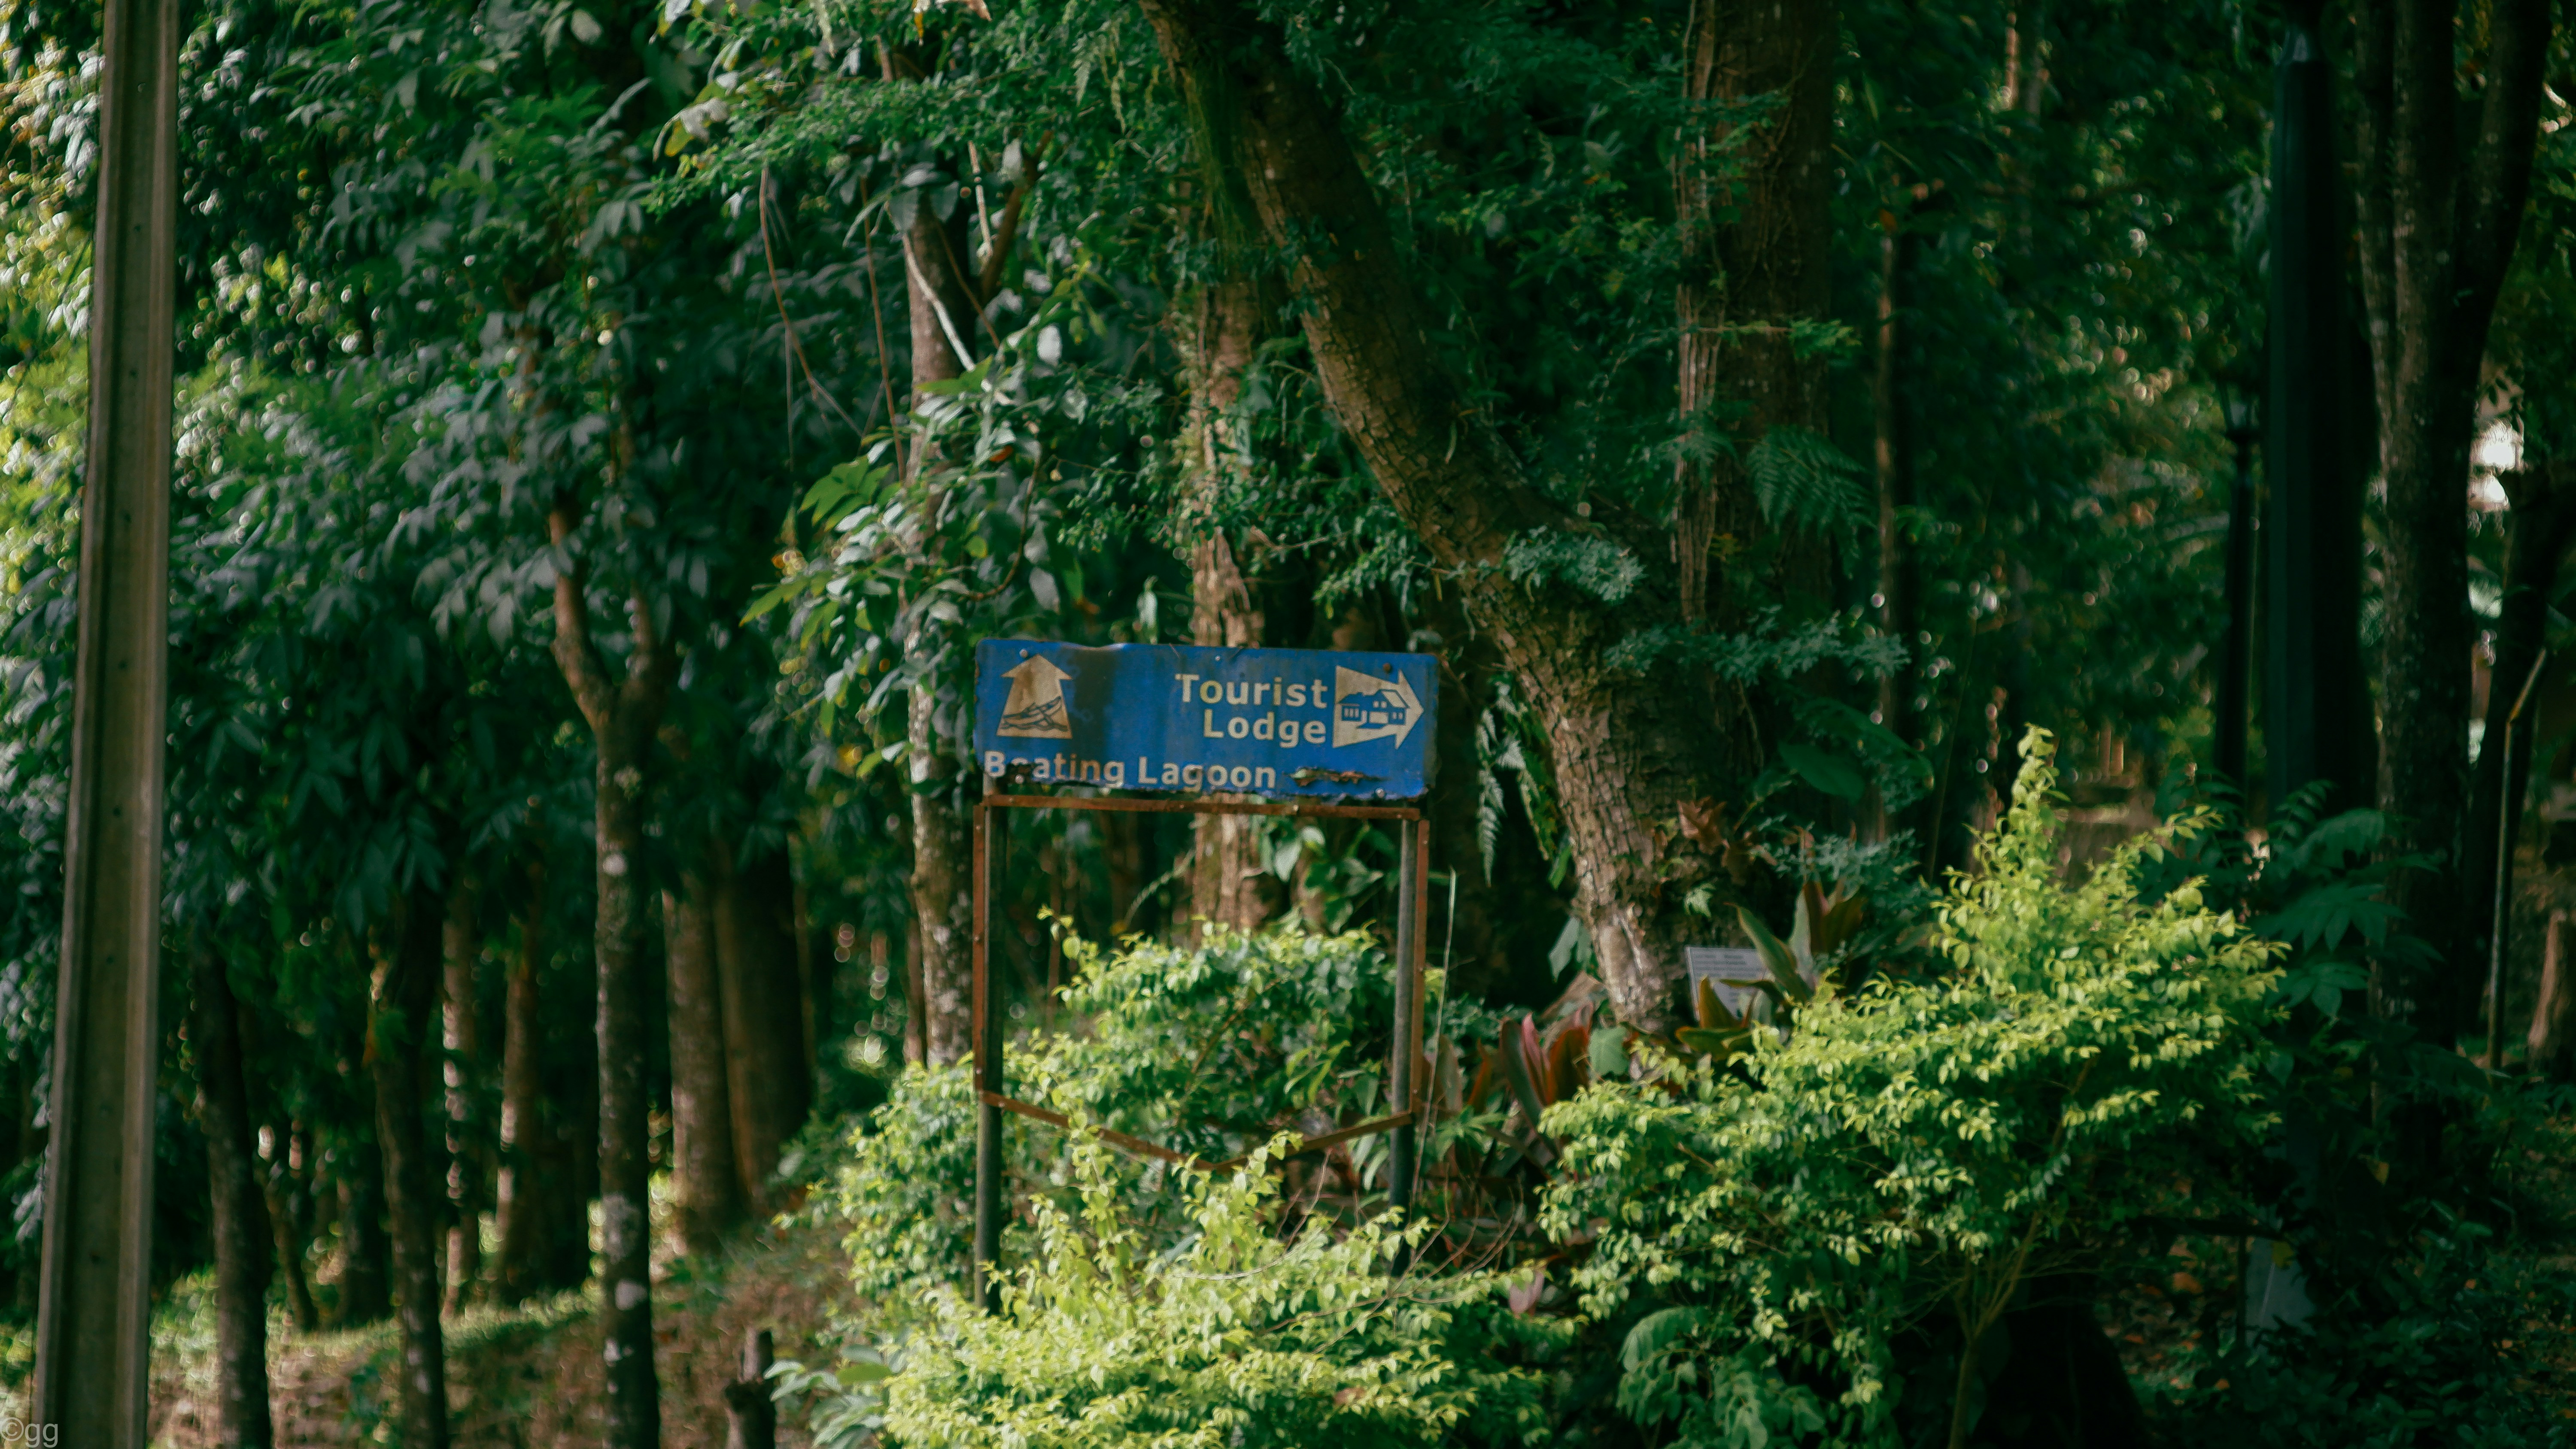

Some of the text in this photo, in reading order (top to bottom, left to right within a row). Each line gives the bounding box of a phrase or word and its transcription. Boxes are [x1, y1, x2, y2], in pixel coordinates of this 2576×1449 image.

[1175, 673, 1328, 709] Tourist
[1203, 708, 1327, 748] Lodge
[1138, 756, 1275, 792] Lagoon
